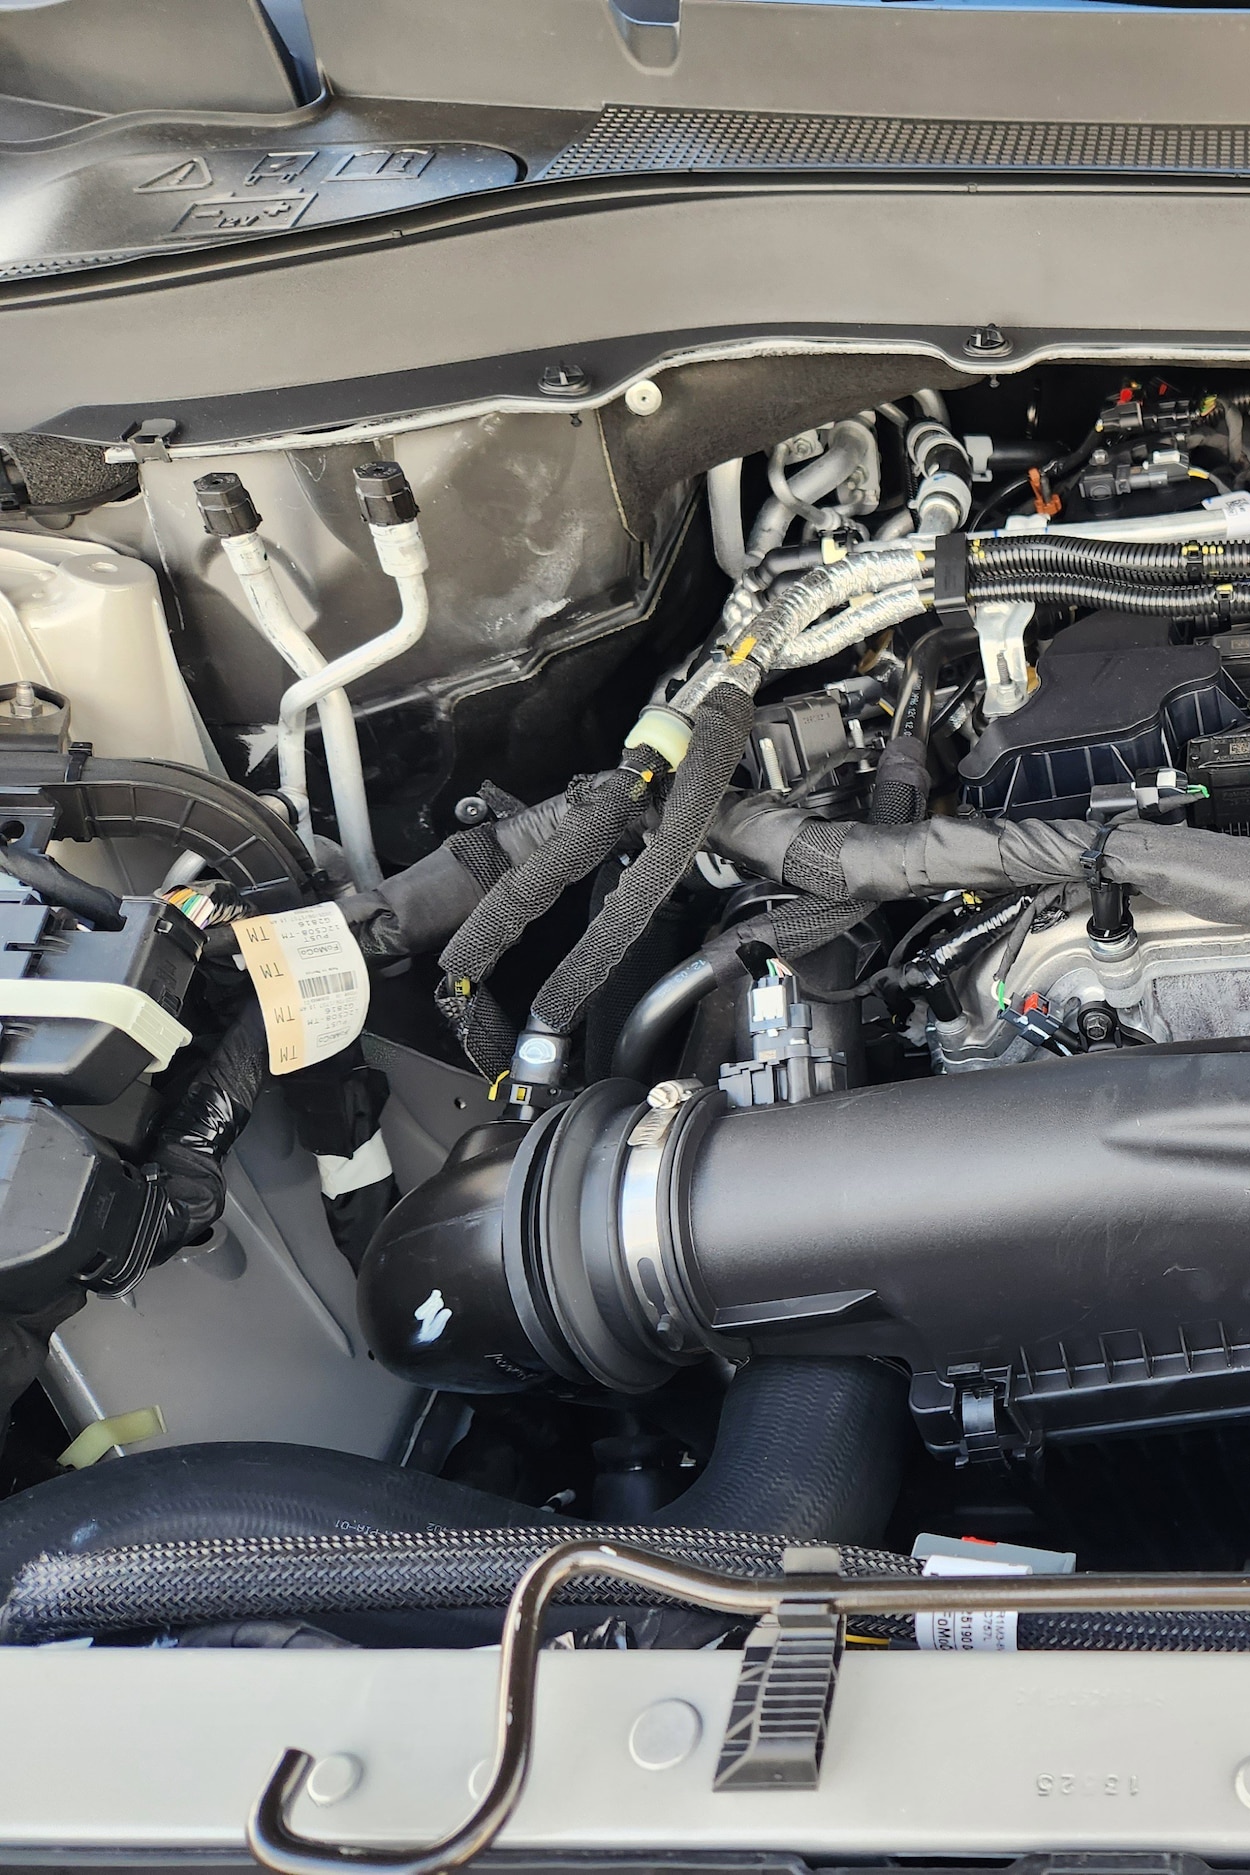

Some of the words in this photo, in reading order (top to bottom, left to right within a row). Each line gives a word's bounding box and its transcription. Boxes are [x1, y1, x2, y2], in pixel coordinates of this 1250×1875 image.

[216, 215, 259, 228] 12V
[245, 926, 271, 943] TM
[299, 945, 340, 957] FoMoCo
[259, 962, 285, 980] TM
[274, 1005, 296, 1023] TM
[279, 1045, 299, 1063] TM
